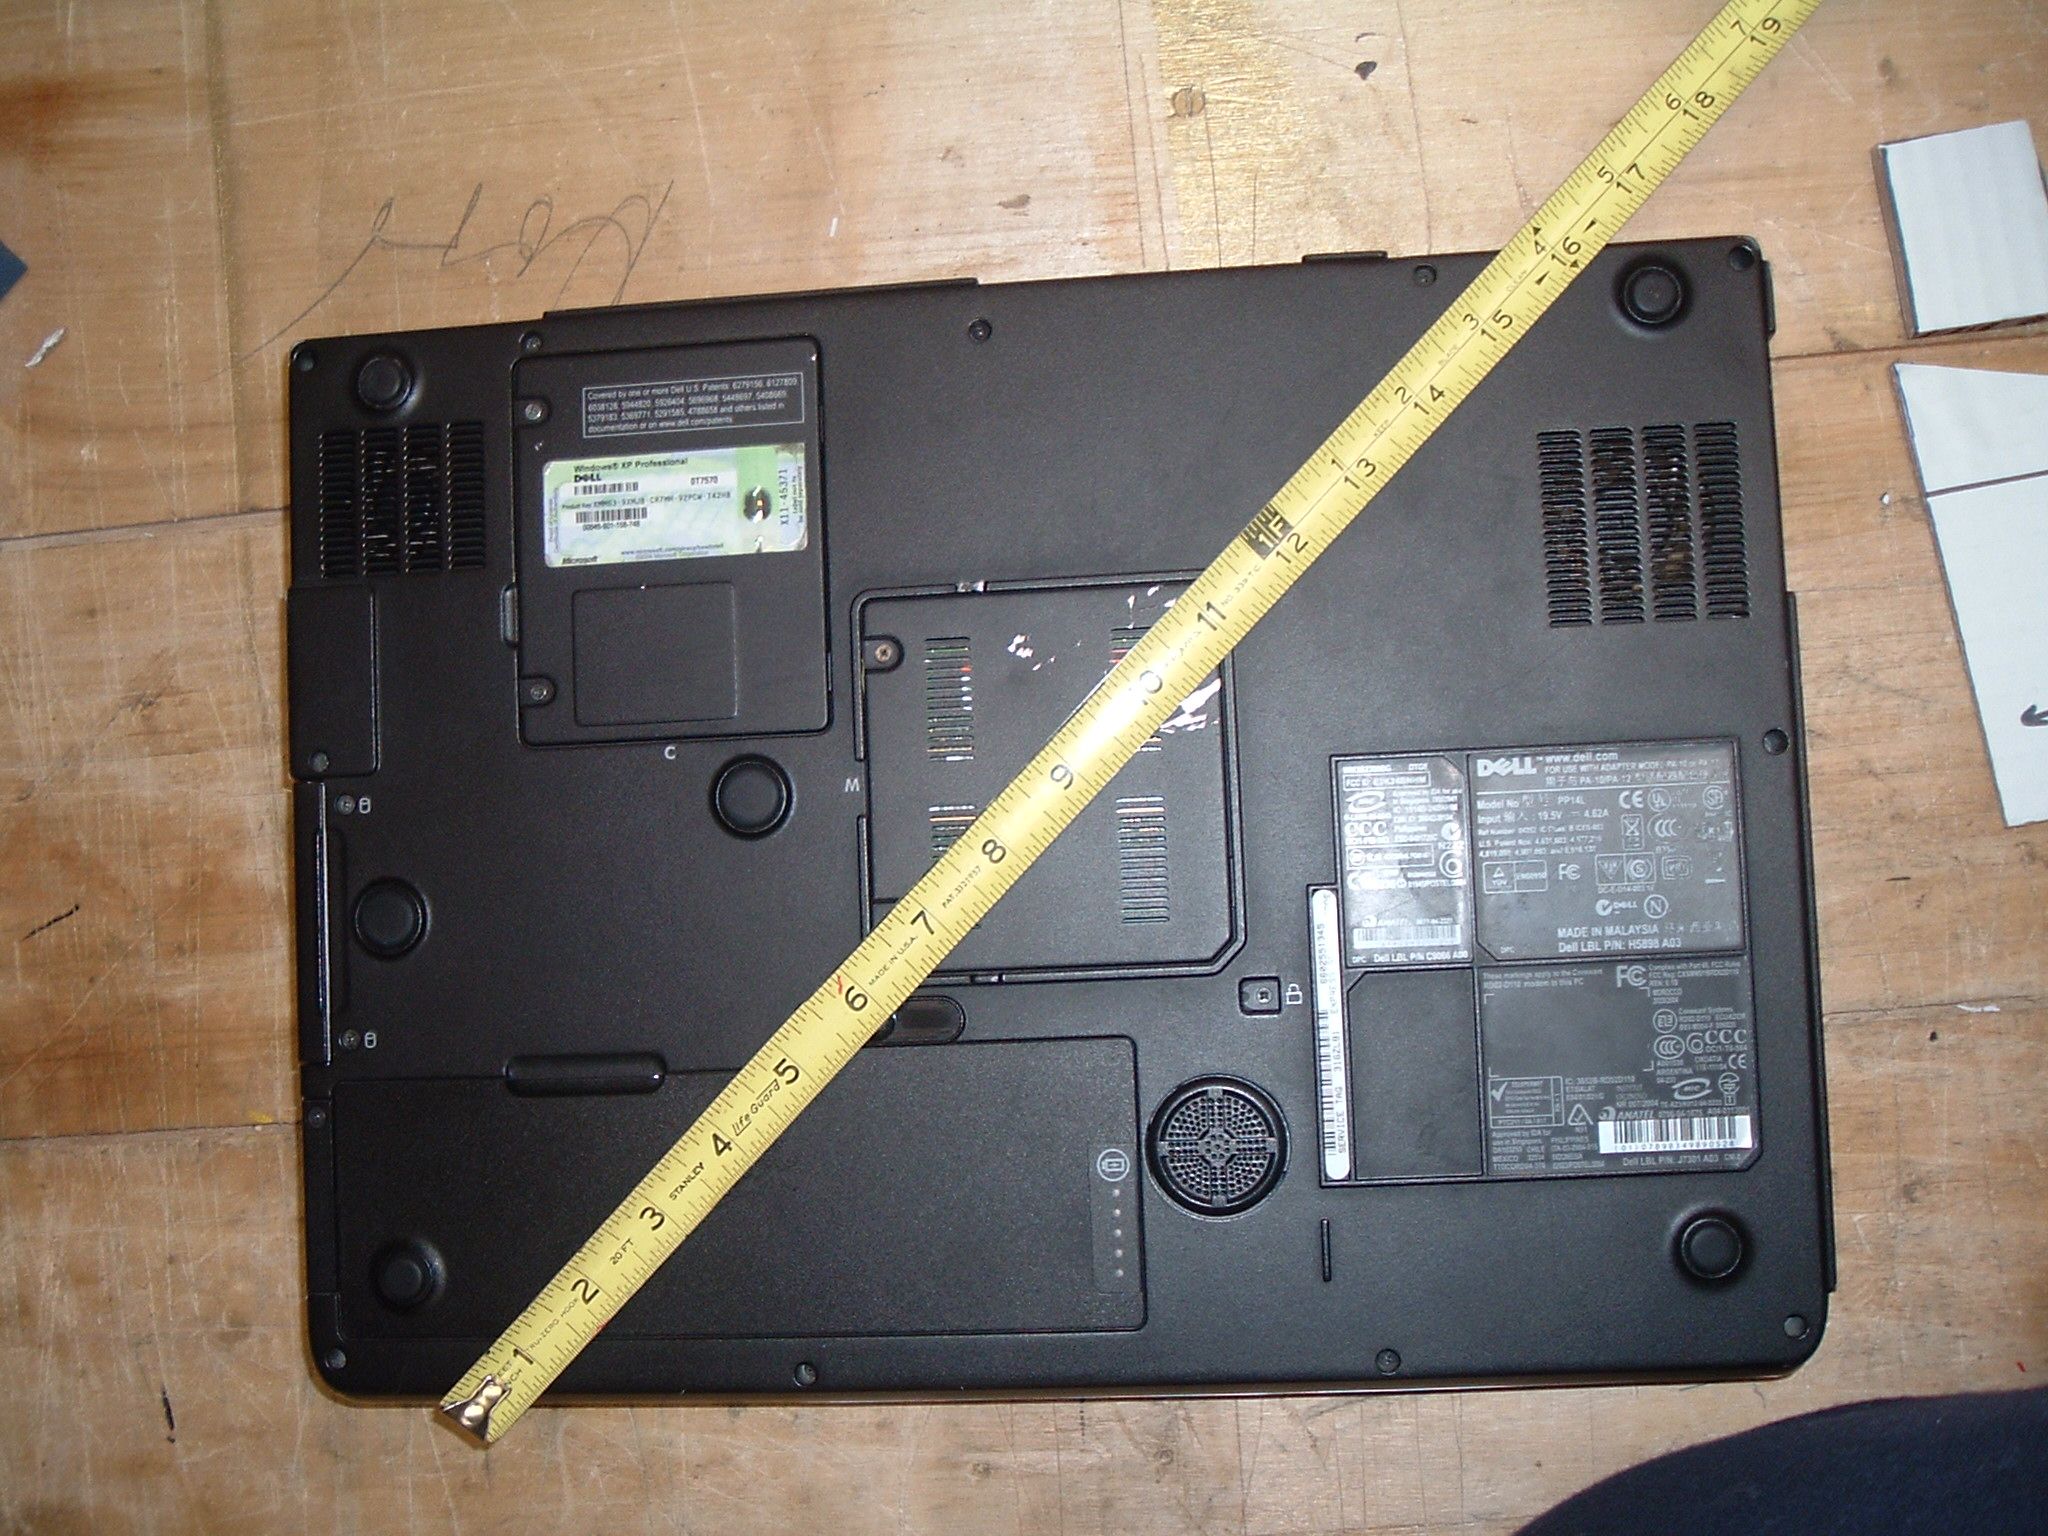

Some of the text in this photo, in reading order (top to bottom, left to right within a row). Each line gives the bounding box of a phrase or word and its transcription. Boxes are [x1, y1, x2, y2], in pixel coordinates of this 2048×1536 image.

[1730, 20, 1748, 36] 7
[1750, 16, 1781, 48] 19
[1665, 93, 1682, 111] 6
[1682, 90, 1715, 121] 18
[1597, 165, 1615, 184] 5
[1616, 163, 1646, 195] 17
[1532, 241, 1547, 255] 4
[1551, 236, 1582, 267] 16
[1462, 312, 1481, 331] 3
[1480, 309, 1514, 343] 15
[1394, 386, 1413, 405] 2
[1413, 384, 1445, 416] 14
[621, 461, 633, 469] XP
[635, 458, 688, 468] Professional
[1330, 457, 1344, 471] 1
[1343, 457, 1377, 491] 13
[574, 473, 602, 483] DELL
[1276, 532, 1309, 564] 12
[1197, 601, 1227, 632] 11
[664, 746, 676, 760] C
[1477, 752, 1618, 777] DELL www.dell.com
[844, 778, 861, 793] M
[1050, 764, 1074, 790] 9
[1476, 799, 1504, 809] Model
[1619, 790, 1643, 809] CE
[1477, 815, 1501, 824] Input
[981, 839, 1006, 864] 8
[910, 910, 934, 935] 7
[1557, 927, 1588, 938] MADE
[1591, 926, 1602, 937] IN
[1605, 924, 1659, 936] MALAYSIA
[1559, 942, 1578, 952] Dell
[1581, 941, 1601, 951] LBL
[1661, 938, 1681, 948] A03
[1373, 953, 1390, 962] Dell
[1391, 953, 1408, 962] LBL
[844, 985, 868, 1012] 6
[1705, 1029, 1747, 1044] CCC
[773, 1057, 801, 1086] 5
[1728, 1054, 1747, 1069] CE
[1336, 1111, 1347, 1153] SERVICE
[712, 1133, 732, 1157] 4
[1622, 1157, 1639, 1166] Dell
[1641, 1156, 1656, 1165] LBL
[668, 1161, 705, 1200] STANLEY
[639, 1206, 665, 1231] 3
[609, 1238, 634, 1266] 20 FT
[571, 1278, 599, 1305] 2
[512, 1347, 534, 1366] 1
